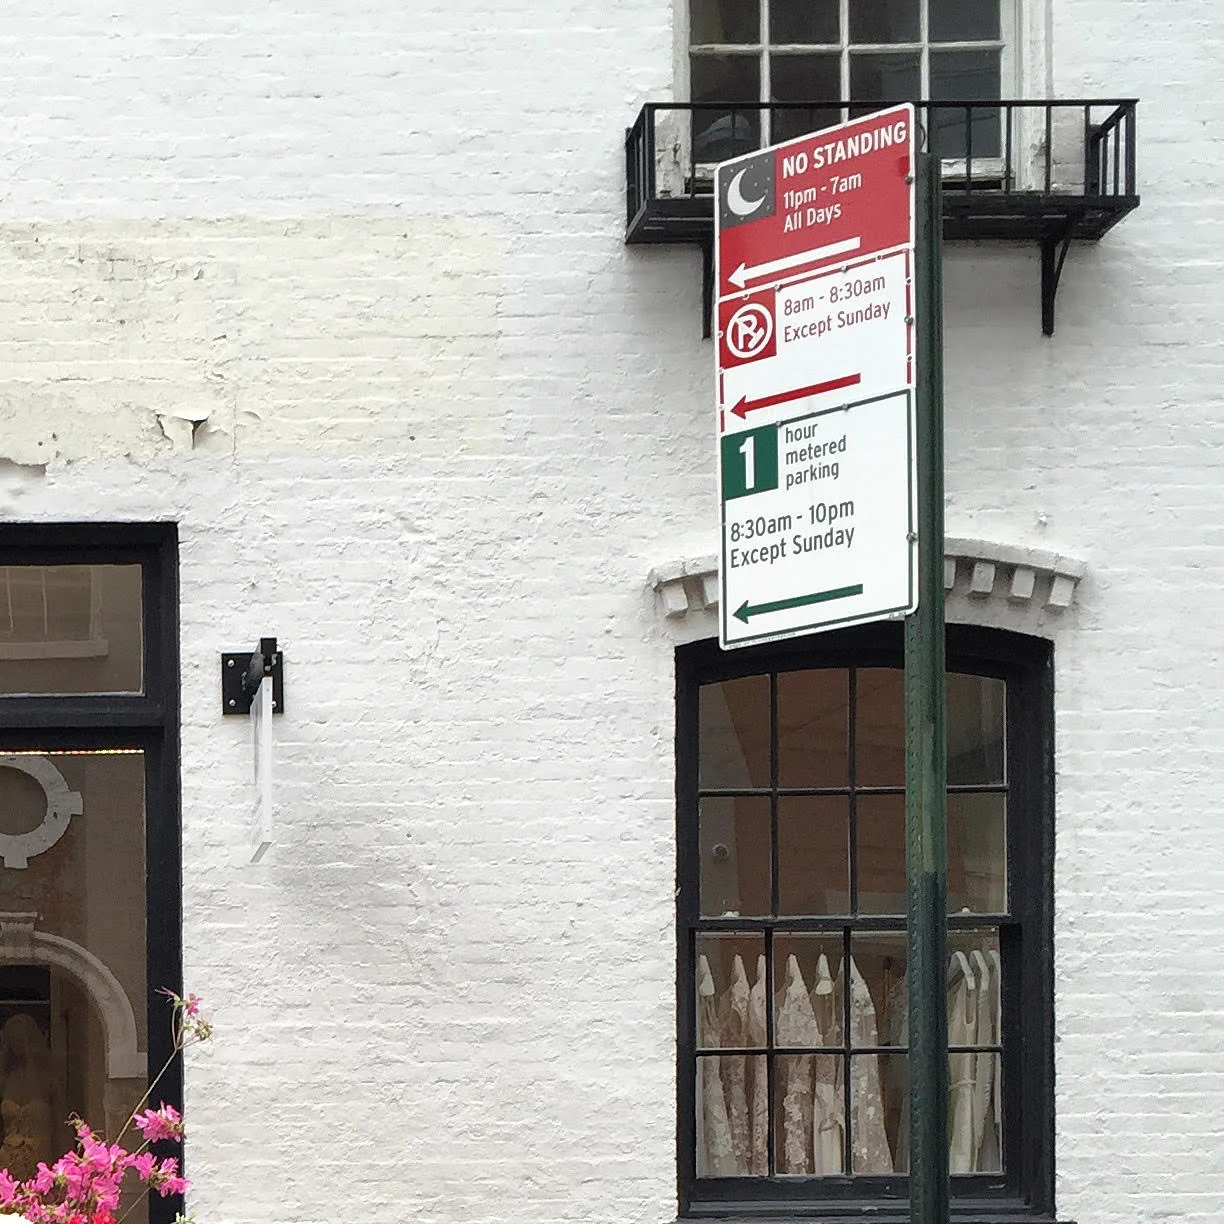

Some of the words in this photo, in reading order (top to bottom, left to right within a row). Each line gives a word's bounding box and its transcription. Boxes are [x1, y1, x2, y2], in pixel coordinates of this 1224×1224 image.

[782, 152, 808, 179] NO
[812, 121, 907, 170] STANDING
[783, 188, 817, 210] 11pm
[830, 172, 862, 195] 7am
[783, 213, 802, 233] All
[806, 203, 842, 228] Days
[783, 293, 815, 316] 8am
[829, 275, 886, 303] 8:30am
[783, 314, 832, 343] Except
[837, 300, 891, 329] Sunday
[785, 423, 818, 444] hour
[785, 435, 847, 465] metered
[739, 435, 755, 490] 1
[785, 461, 840, 491] parking
[730, 514, 792, 542] 8:30am
[808, 500, 855, 525] 10pm
[730, 538, 787, 569] Except
[792, 526, 855, 556] Sunday
